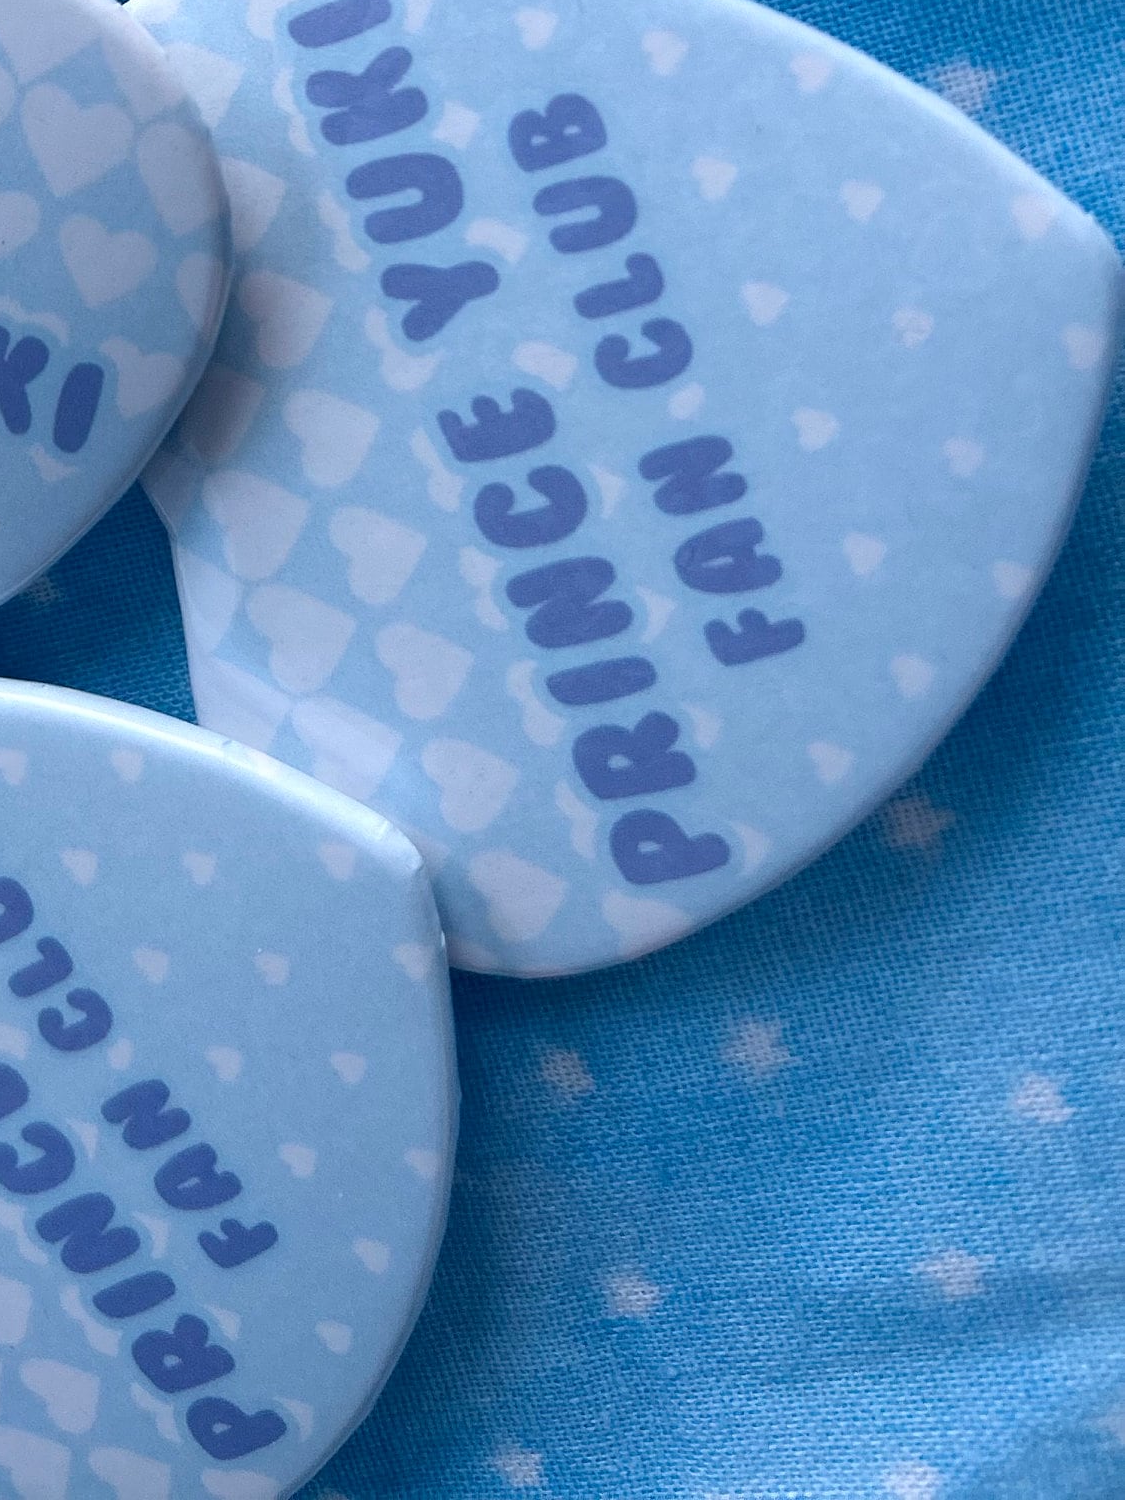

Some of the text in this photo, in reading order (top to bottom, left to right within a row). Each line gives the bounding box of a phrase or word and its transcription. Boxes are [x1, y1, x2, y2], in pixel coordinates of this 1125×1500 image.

[508, 93, 805, 667] FAN CLUB
[437, 388, 731, 885] PRINCE
[101, 1078, 278, 1269] FAN
